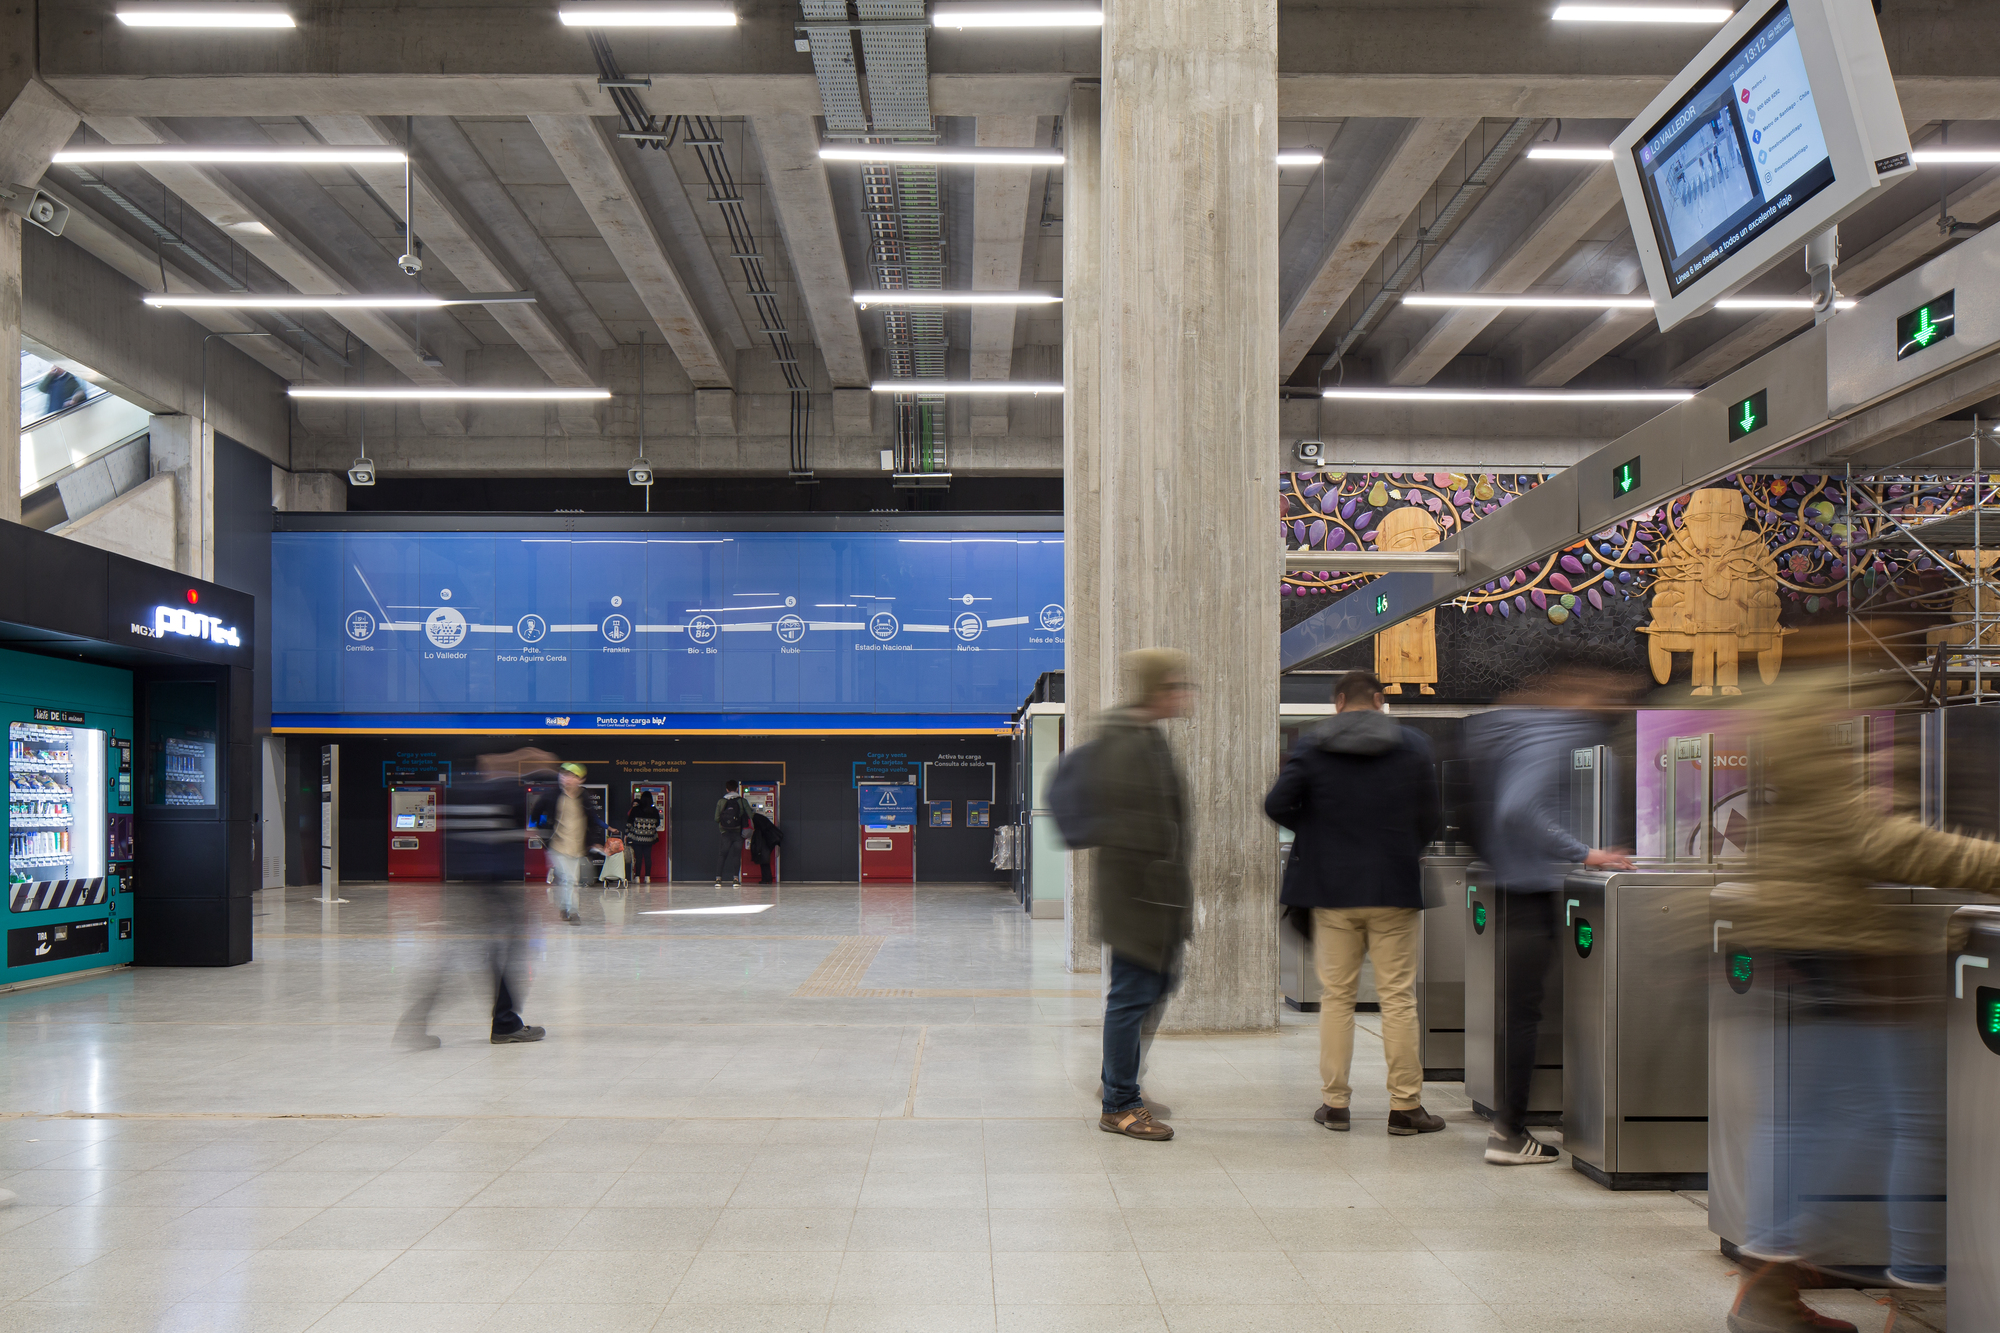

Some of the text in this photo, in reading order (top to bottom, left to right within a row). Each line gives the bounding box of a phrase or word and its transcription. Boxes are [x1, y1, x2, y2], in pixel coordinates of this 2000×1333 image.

[1744, 37, 1767, 64] 13:12
[1779, 101, 1797, 118] Santiago
[1799, 90, 1810, 101] Chile
[1644, 105, 1697, 161] 6 LO VALLEDOR
[1693, 260, 1702, 272] les
[1701, 249, 1719, 266] desea
[1722, 233, 1740, 250] todos
[1739, 227, 1748, 238] un
[1747, 206, 1777, 231] excelente
[1776, 193, 1793, 209] viaje
[131, 623, 155, 638] MGX
[695, 629, 710, 638] Bío
[346, 644, 374, 652] Cerrillos
[780, 646, 801, 654] Ñuble
[957, 644, 980, 652] Ñuñoa
[435, 651, 467, 659] Valledor
[519, 655, 544, 663] Aguirre
[50, 712, 60, 721] DE
[61, 711, 67, 721] ti
[631, 718, 650, 726] carga
[652, 716, 666, 725] bip!
[37, 932, 47, 941] TIRA
